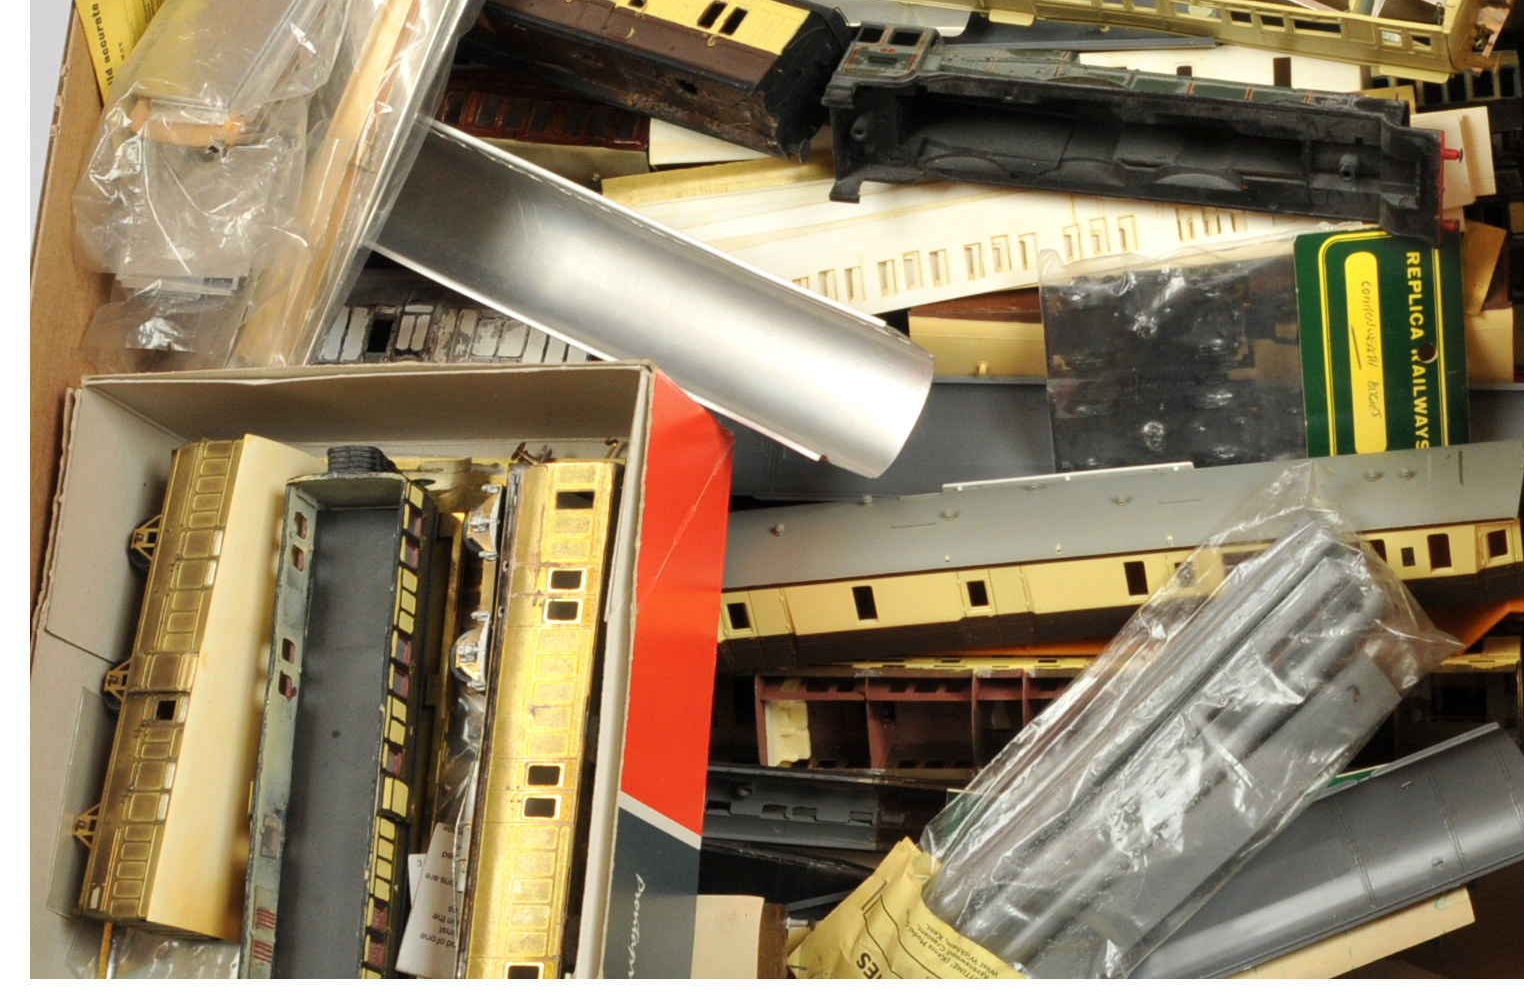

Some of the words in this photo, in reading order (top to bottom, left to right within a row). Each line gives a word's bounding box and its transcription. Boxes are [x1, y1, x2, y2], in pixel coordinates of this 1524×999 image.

[91, 3, 110, 63] accurate
[1406, 251, 1424, 340] REPLICA
[424, 872, 438, 882] are
[431, 913, 445, 923] the
[419, 932, 436, 941] one
[435, 937, 445, 945] of
[907, 926, 926, 946] Model
[915, 923, 946, 951] Crescent,
[924, 922, 943, 940] Kent.
[926, 944, 950, 964] (Kents
[943, 937, 978, 964] Wickham,
